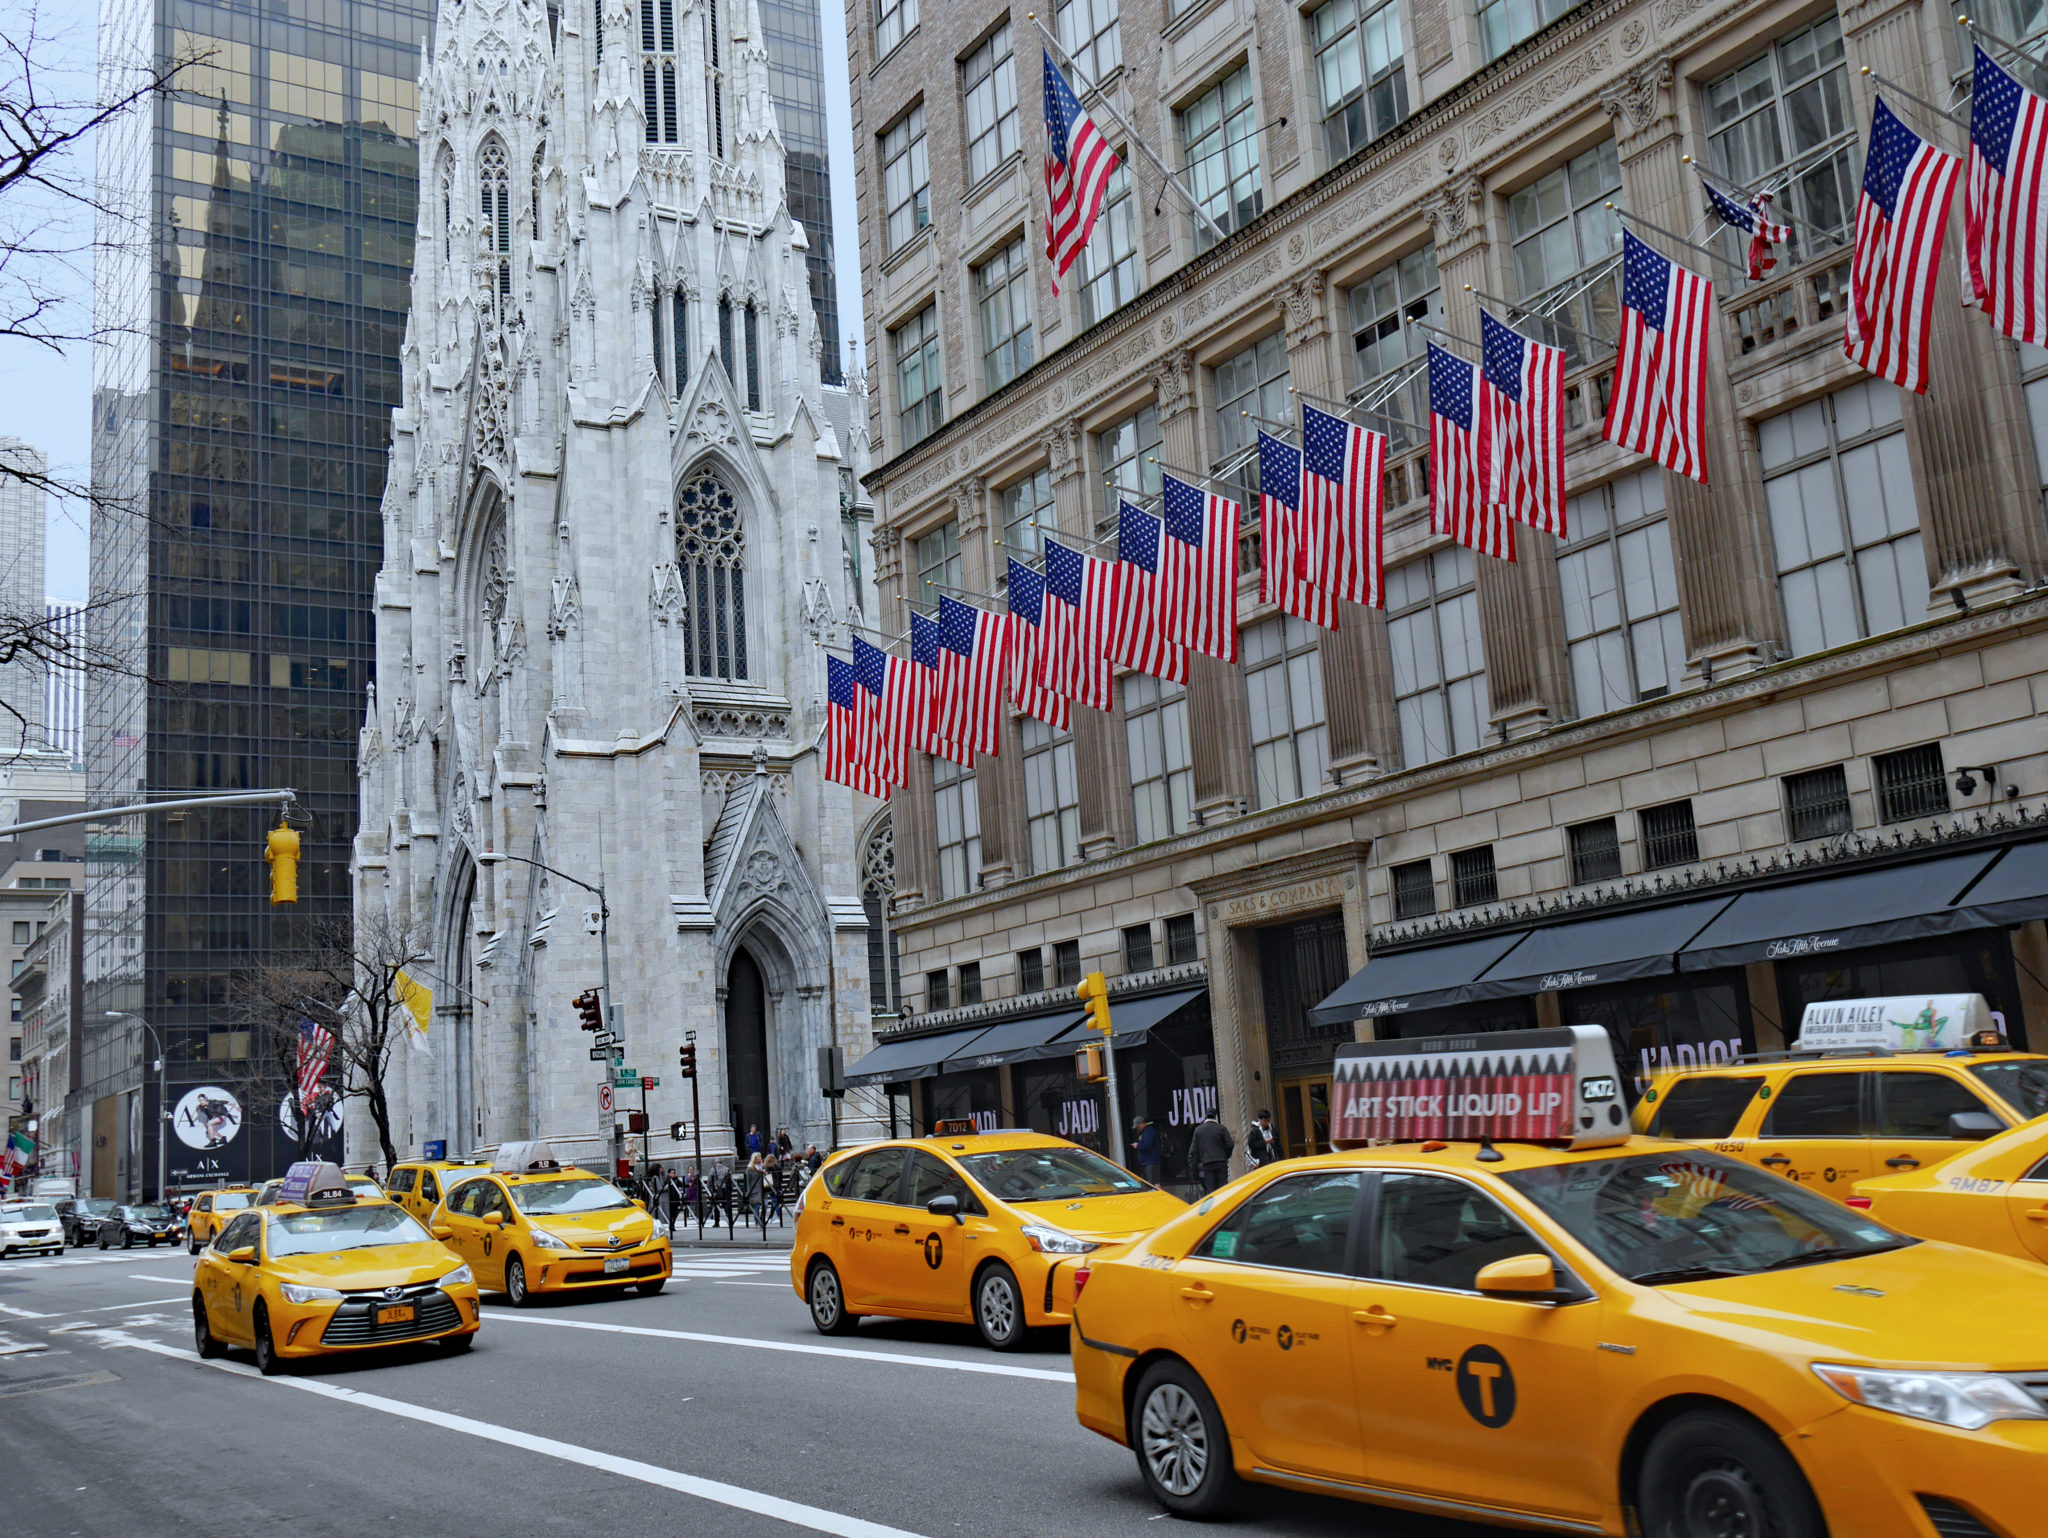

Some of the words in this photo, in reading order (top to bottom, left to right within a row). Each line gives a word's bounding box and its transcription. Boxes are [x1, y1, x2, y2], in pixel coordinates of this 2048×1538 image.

[1229, 900, 1256, 915] SAKS
[1270, 879, 1335, 906] COMPANY
[1806, 1008, 1845, 1025] ALVIN
[1847, 1006, 1886, 1023] AILEY
[1583, 1080, 1616, 1098] 2K72
[1344, 1097, 1382, 1118] ART
[1385, 1095, 1443, 1118] STICK
[1447, 1093, 1522, 1117] LIQUID
[1527, 1092, 1562, 1115] LIP
[1950, 1177, 2004, 1193] 9M87
[1426, 1357, 1453, 1372] NYC
